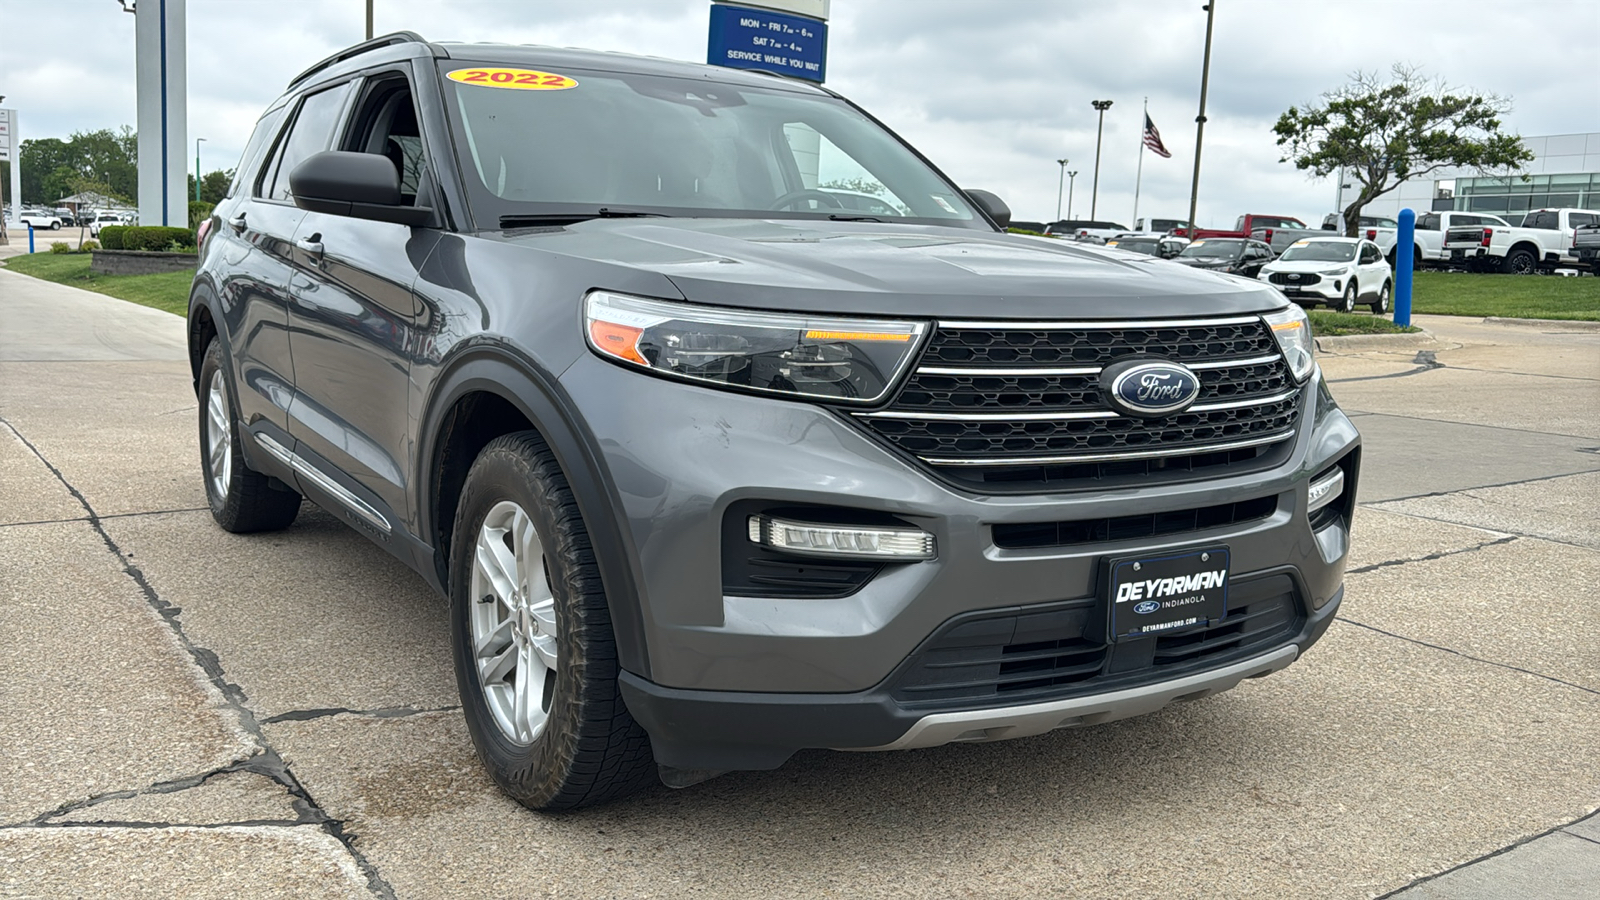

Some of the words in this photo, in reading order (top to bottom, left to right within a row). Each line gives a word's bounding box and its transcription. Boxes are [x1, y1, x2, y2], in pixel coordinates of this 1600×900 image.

[740, 18, 760, 29] MON
[768, 22, 781, 32] FRI
[753, 36, 769, 47] SAT
[727, 49, 762, 62] SERVICE
[764, 54, 788, 66] WHILE
[789, 58, 804, 69] YOU
[805, 60, 820, 72] WAIT
[463, 71, 566, 87] 2022
[1137, 373, 1183, 401] Ford
[1115, 569, 1226, 603] DEYARMAN
[1138, 602, 1156, 612] Ford
[1162, 594, 1206, 608] INDIANOLA
[1142, 617, 1197, 633] DEYARMANFORD.COM
